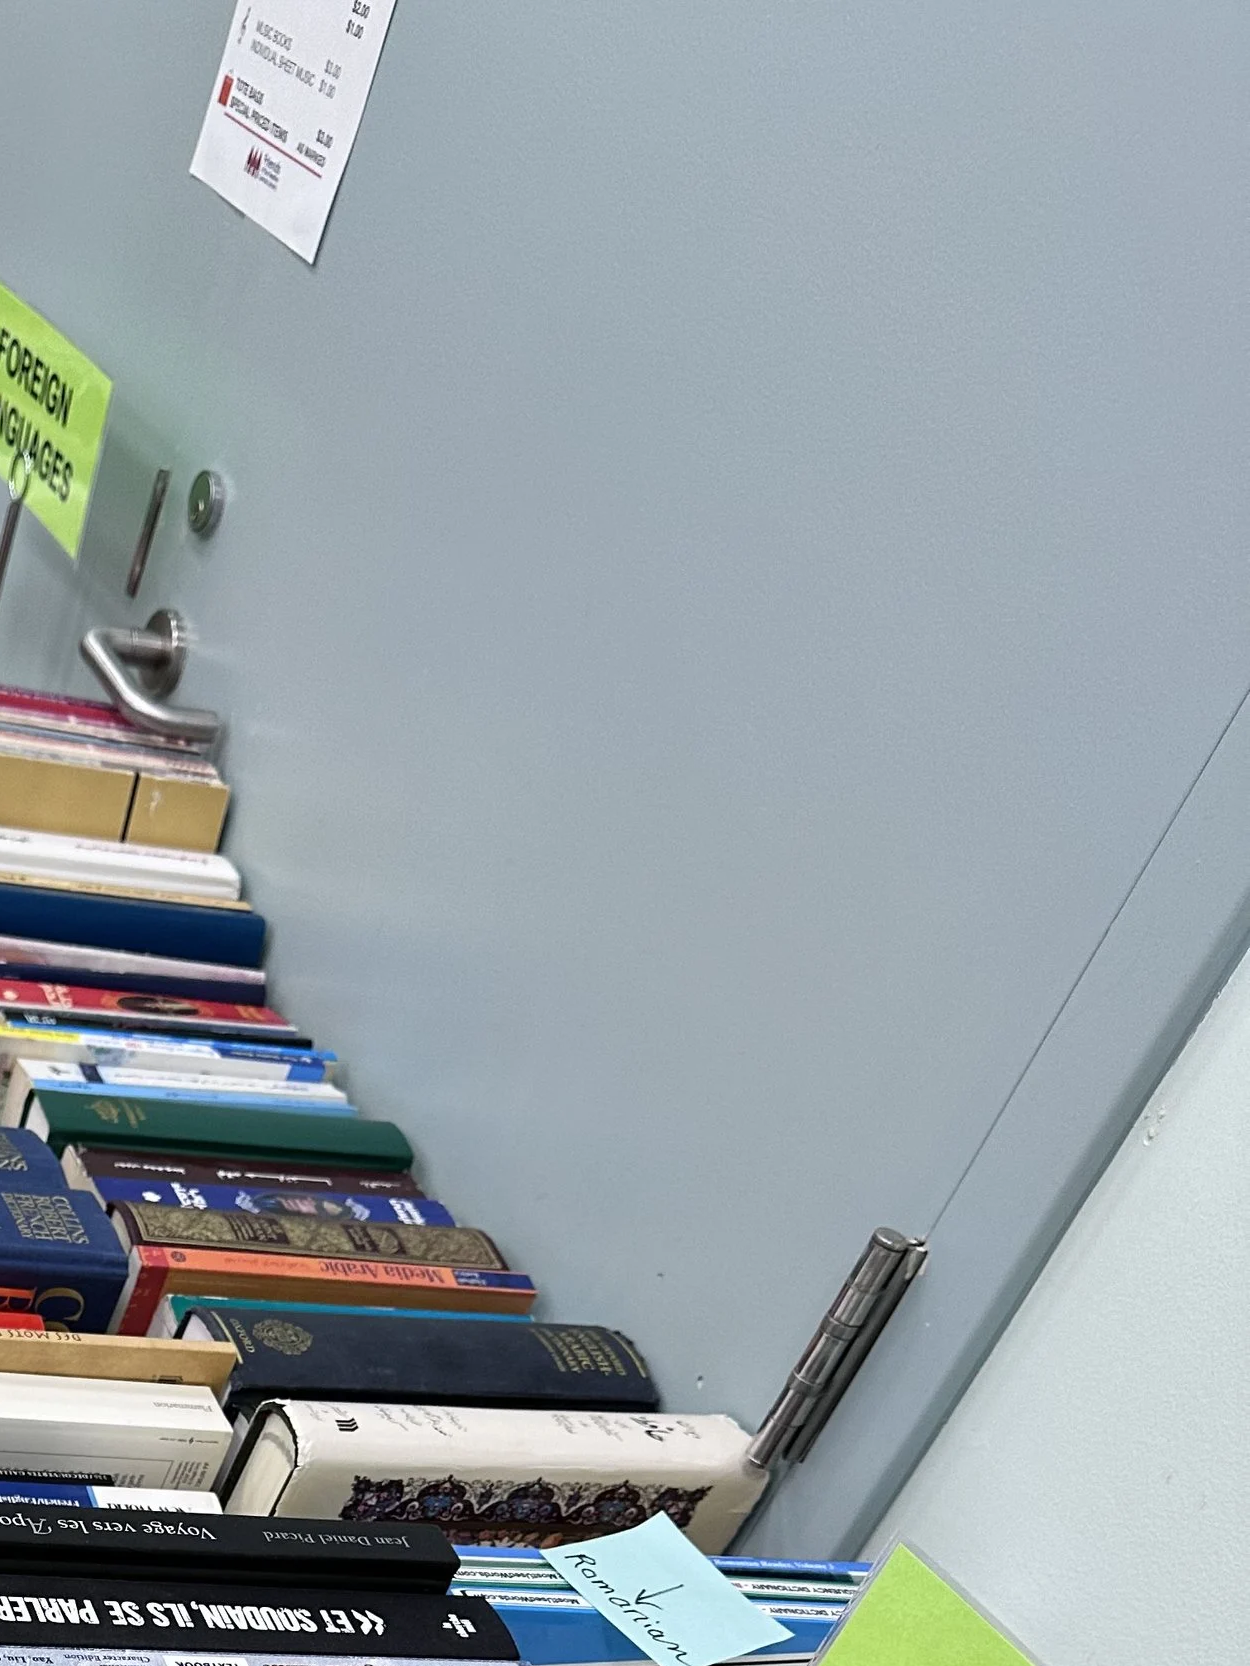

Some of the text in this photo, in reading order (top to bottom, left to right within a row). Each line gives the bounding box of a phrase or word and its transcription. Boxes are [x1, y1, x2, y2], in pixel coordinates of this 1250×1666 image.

[352, 0, 370, 19] $2.00
[346, 19, 364, 39] $1.00
[317, 1259, 447, 1284] Media Arabic
[56, 1517, 89, 1534] les
[92, 1520, 137, 1534] vers
[141, 1519, 218, 1541] Voyage
[103, 1598, 142, 1629] SE
[564, 1553, 692, 1666] Romanian
[316, 1609, 355, 1633] ET
